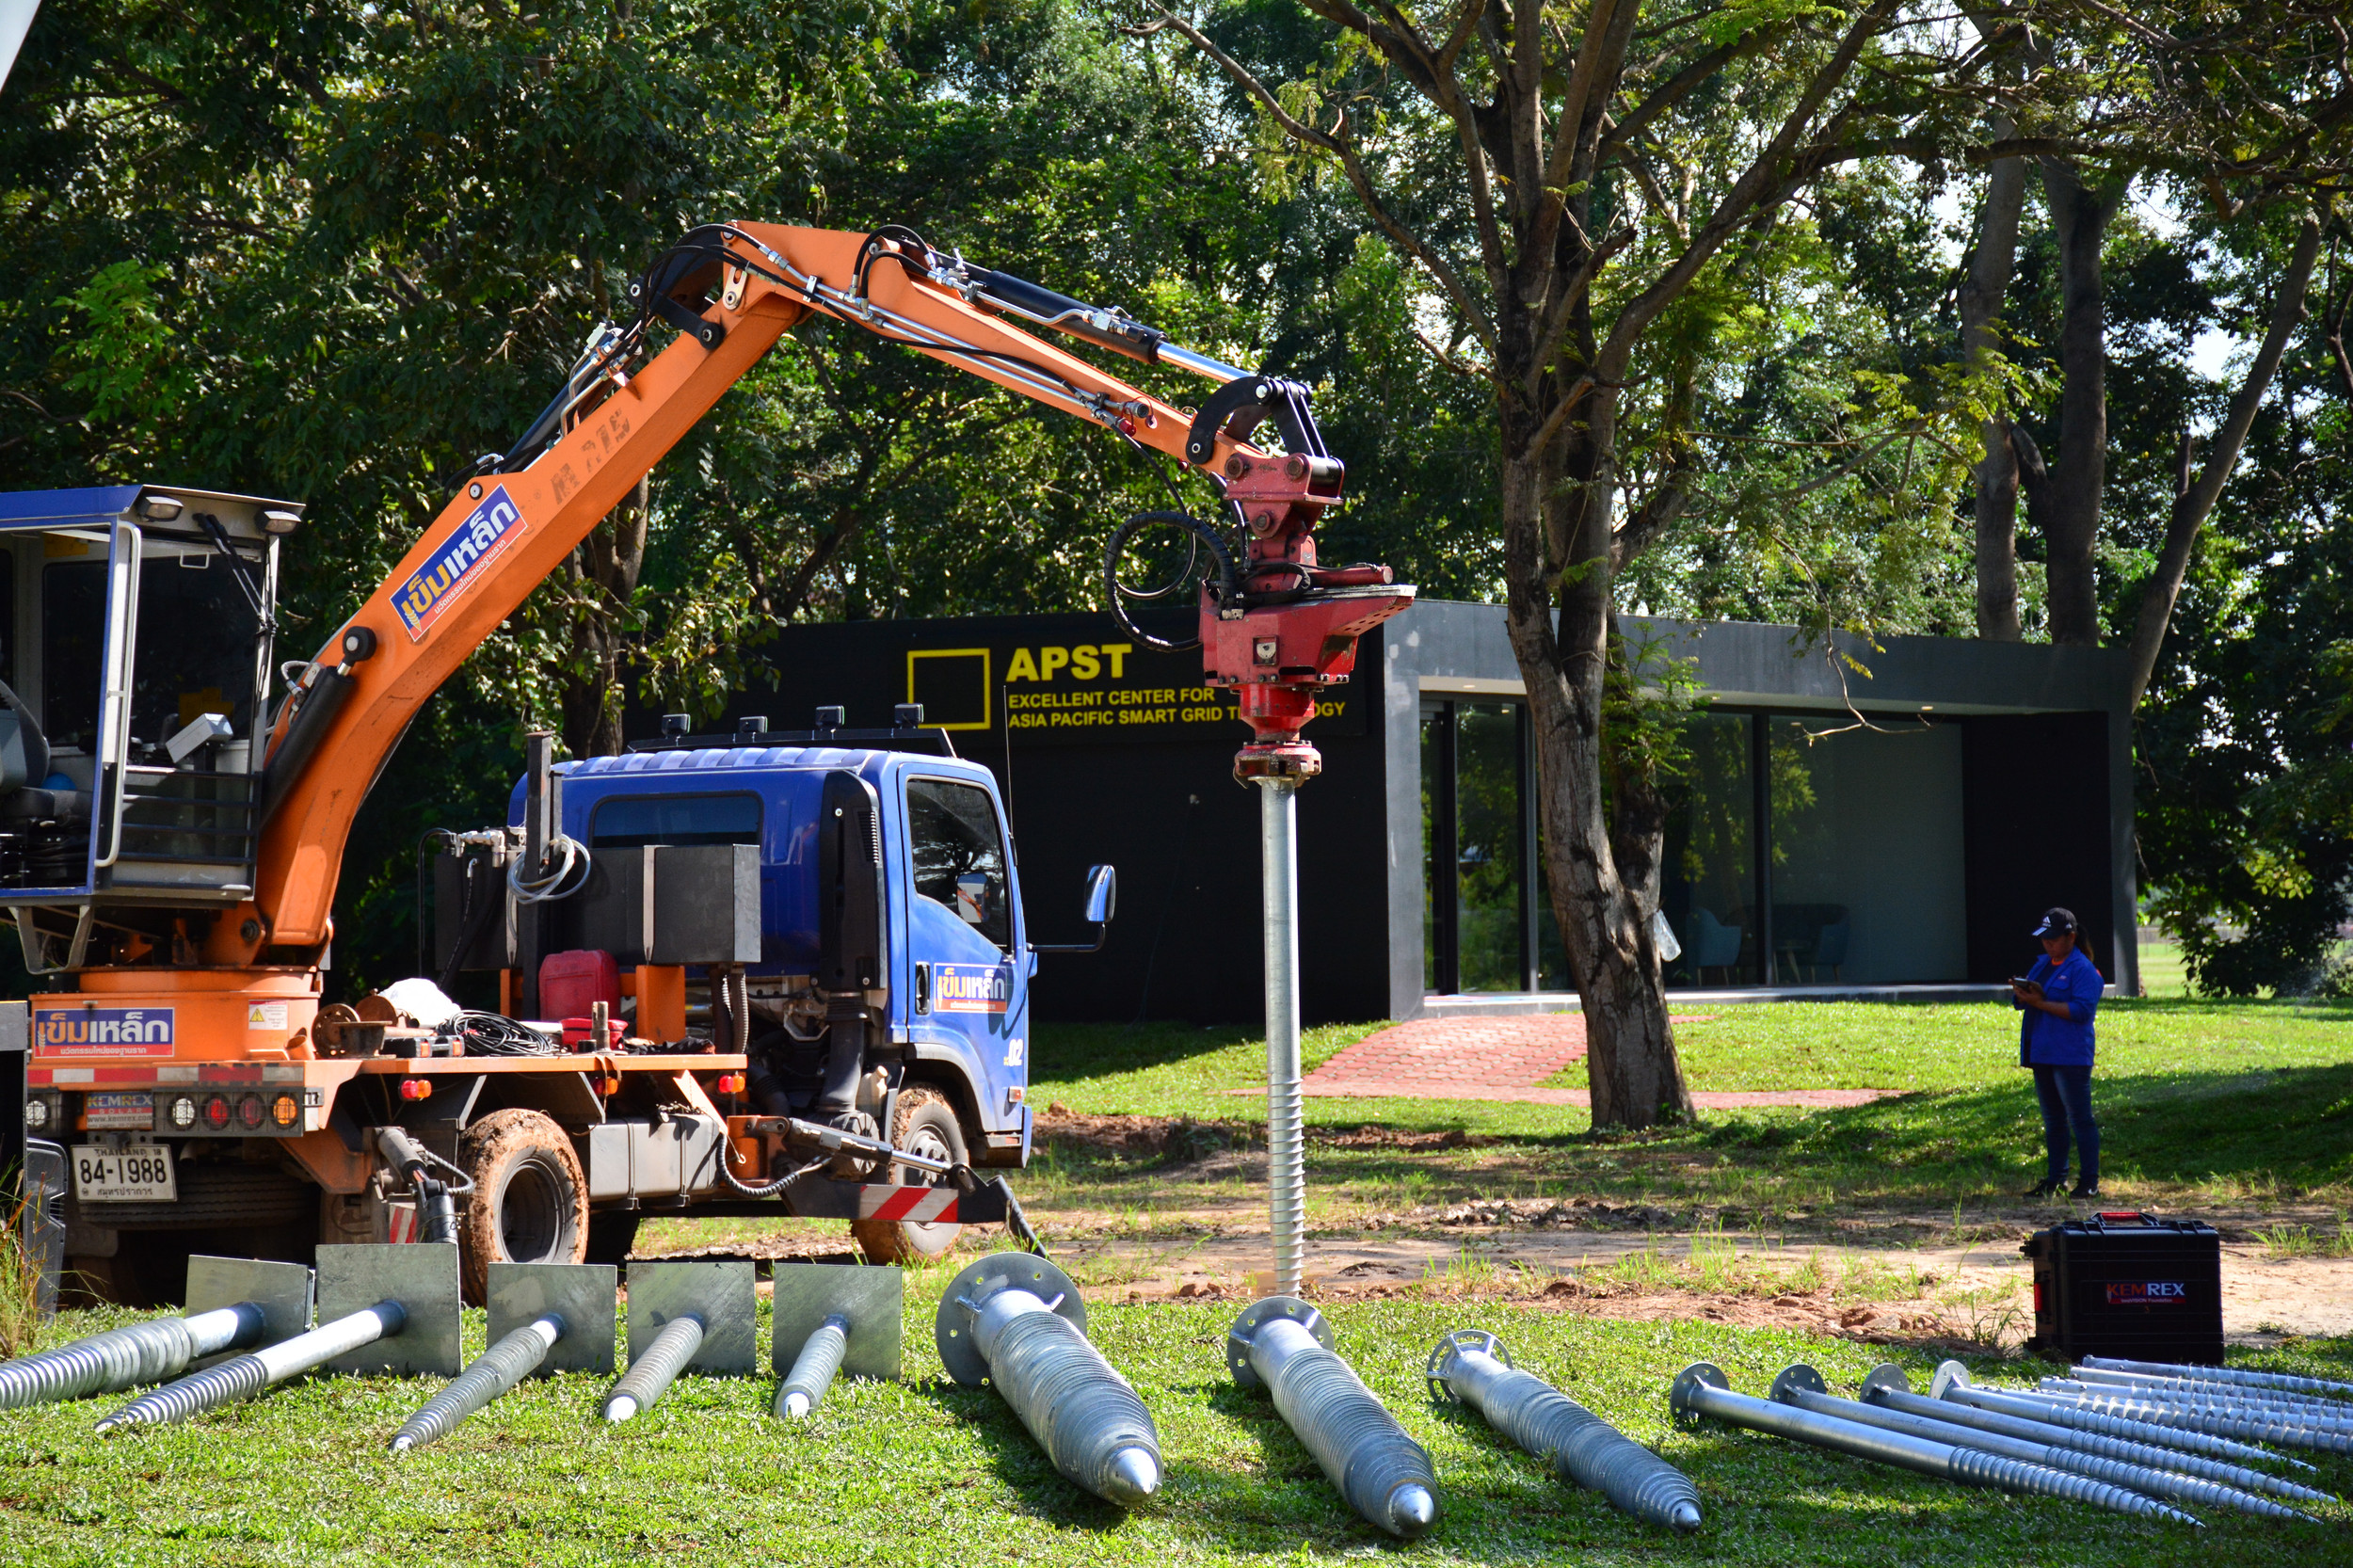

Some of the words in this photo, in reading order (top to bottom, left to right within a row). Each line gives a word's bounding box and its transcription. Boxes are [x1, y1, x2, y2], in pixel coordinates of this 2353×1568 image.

[401, 502, 517, 629] เข็มเหล็ก
[1005, 644, 1132, 682] APST
[1008, 692, 1104, 709] EXCELLENT
[1108, 689, 1176, 705] CENTER
[1180, 688, 1215, 702] FOR
[1008, 713, 1048, 728] ASIA
[1050, 711, 1113, 727] PACIFIC
[1118, 708, 1177, 725] SMART
[1181, 708, 1223, 722] GRID
[38, 1011, 169, 1045] เข็มเหล็ก
[88, 1095, 152, 1107] KEMREX
[80, 1158, 167, 1184] 84-1988
[97, 1188, 152, 1198] สมุทรปราการ
[2106, 1283, 2185, 1296] KEMREX
